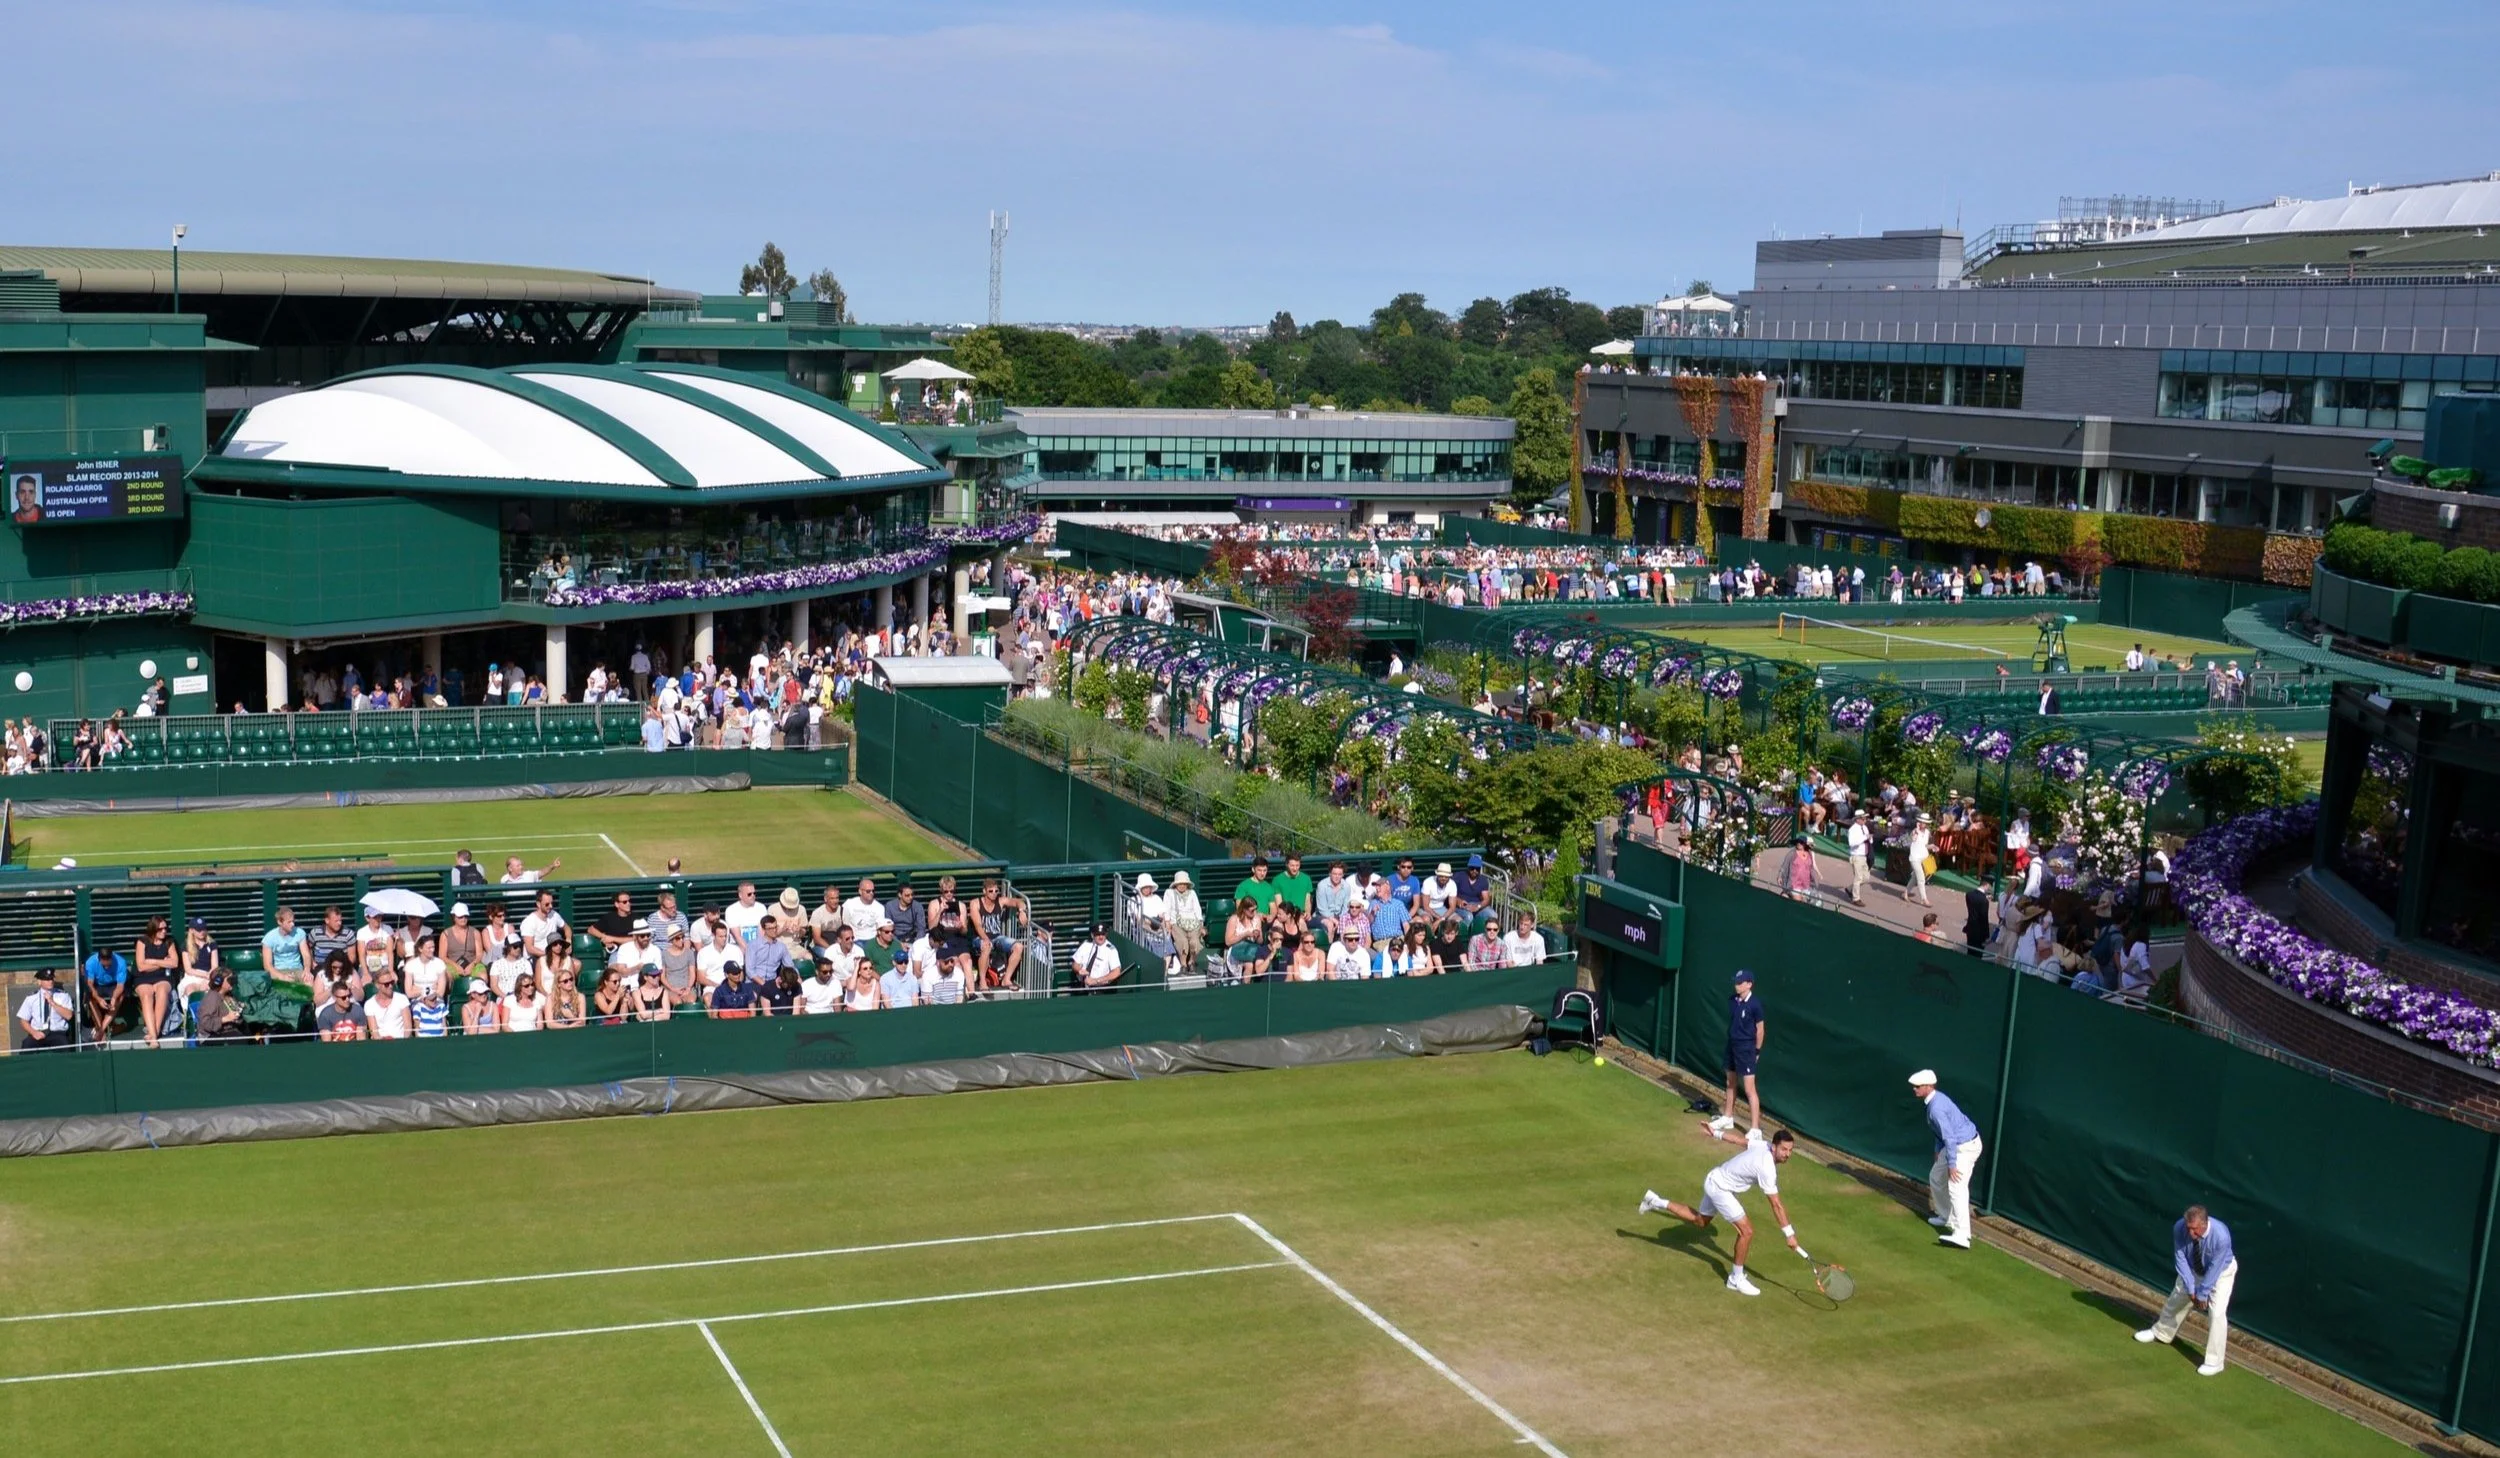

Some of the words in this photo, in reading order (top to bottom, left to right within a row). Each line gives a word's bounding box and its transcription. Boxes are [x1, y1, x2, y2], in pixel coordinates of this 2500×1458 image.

[76, 461, 94, 470] John
[95, 460, 119, 469] ISNER
[66, 473, 89, 482] SLAM
[90, 472, 122, 481] RECORD
[123, 471, 159, 480] 2013-2014
[45, 484, 73, 493] ROLAND
[74, 483, 103, 492] GARROS
[141, 481, 164, 489] ROUND
[46, 496, 88, 506] AUSTRALIAN
[89, 495, 108, 504] OPEN
[127, 494, 141, 502] 3RD
[141, 493, 165, 502] ROUND
[46, 510, 56, 518] US
[56, 509, 76, 517] OPEN
[127, 506, 141, 514] 3RD
[141, 505, 165, 513] ROUND
[1585, 881, 1602, 898] IBM
[1624, 924, 1646, 942] mph
